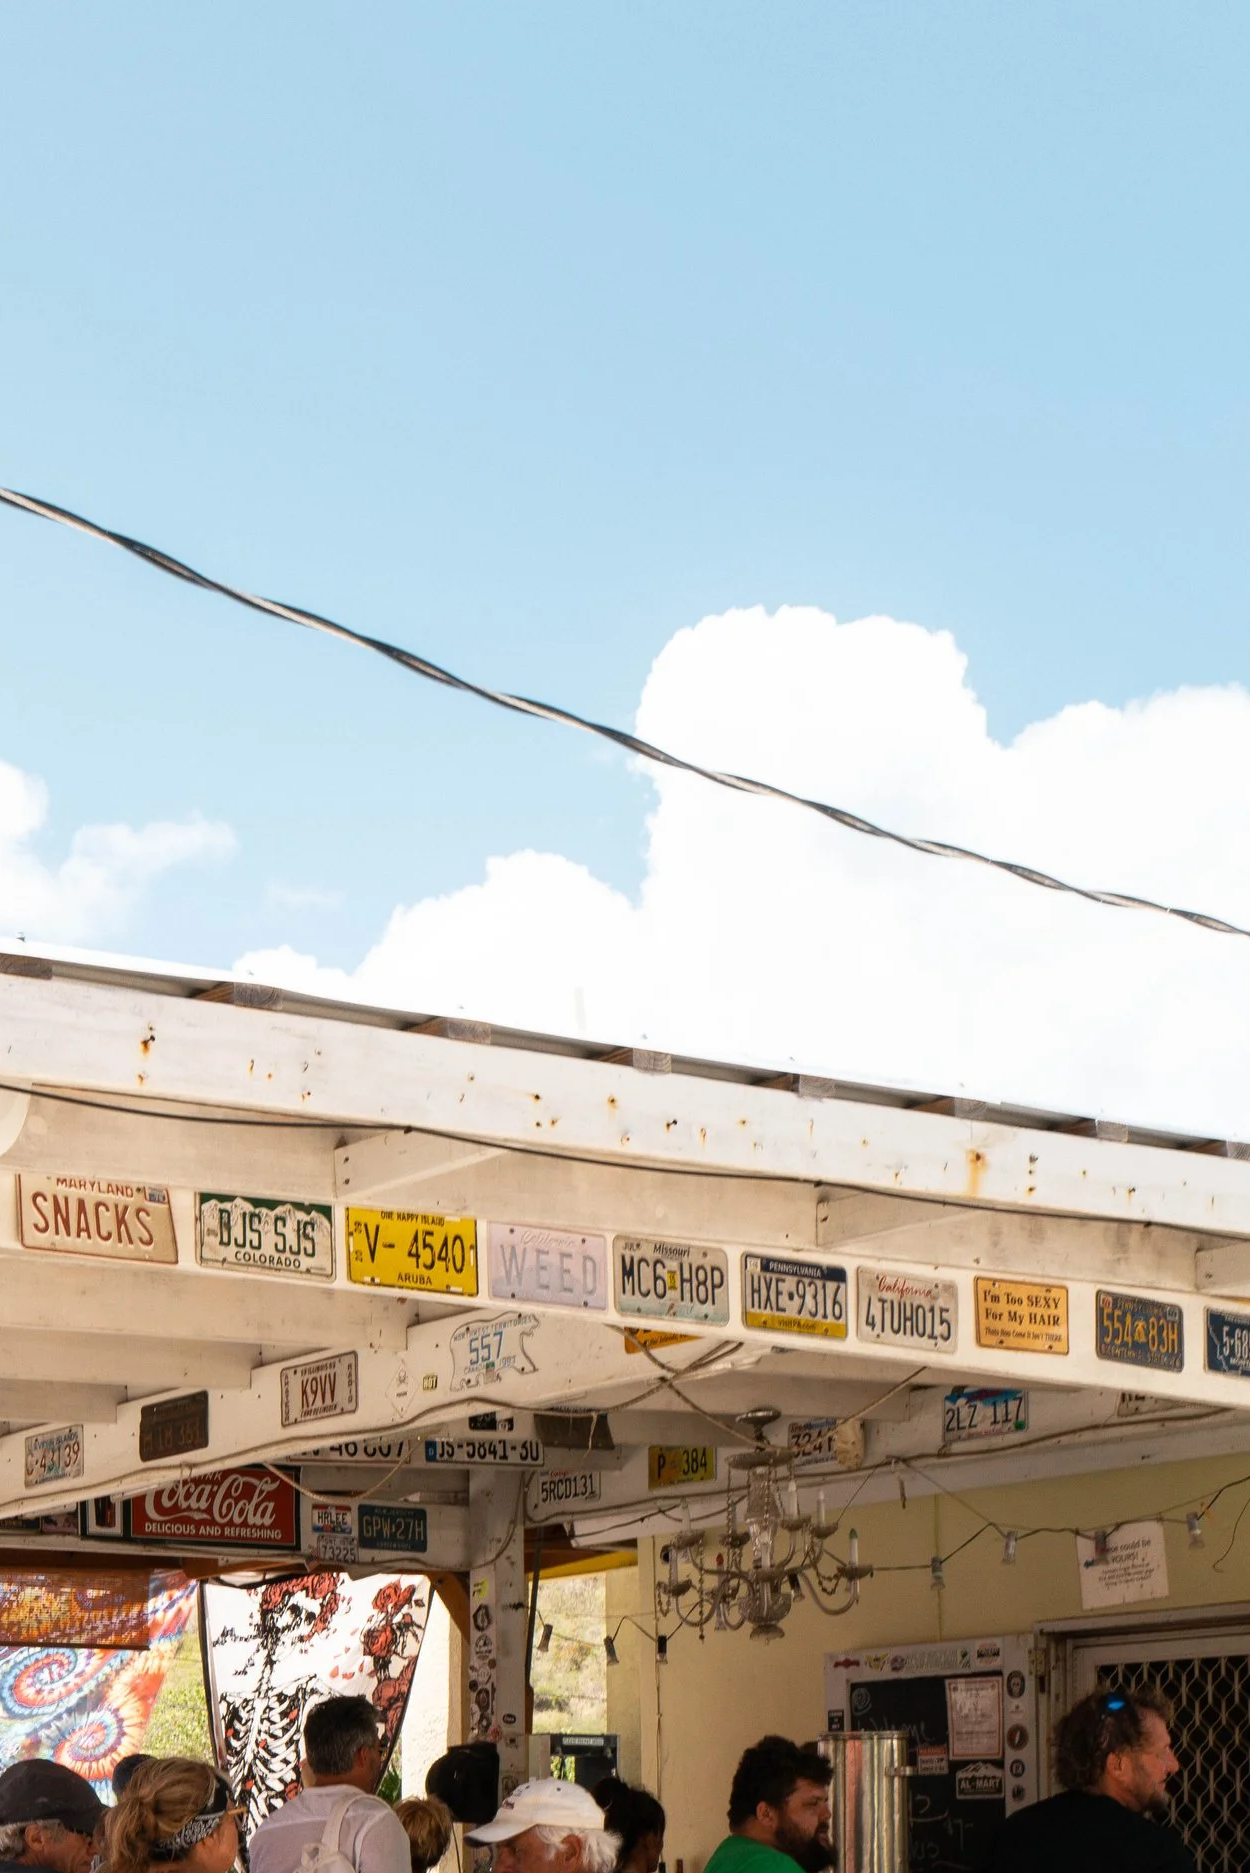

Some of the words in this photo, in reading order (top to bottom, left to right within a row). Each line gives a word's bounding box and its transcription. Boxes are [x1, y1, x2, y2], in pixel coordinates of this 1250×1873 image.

[56, 1177, 134, 1198] MARYLAND
[31, 1191, 154, 1246] SNACKS
[381, 1211, 393, 1220] ONE
[396, 1212, 419, 1223] HAPPY
[421, 1215, 445, 1227] ISLAND
[234, 1250, 301, 1269] COLORADO
[407, 1229, 465, 1274] 4540
[653, 1243, 690, 1258] Missouri
[397, 1272, 433, 1286] ARUBA
[500, 1244, 596, 1296] WEED
[621, 1253, 667, 1300] MC6
[679, 1262, 724, 1306] H8P
[769, 1261, 822, 1278] PENNSYLVANIA
[878, 1274, 933, 1301] California
[983, 1289, 1000, 1304] I'm
[1004, 1291, 1023, 1306] Too
[1027, 1294, 1061, 1309] SEXY
[985, 1307, 1003, 1321] For
[1008, 1309, 1025, 1326] My
[1029, 1312, 1060, 1326] HAIR
[1103, 1307, 1132, 1346] 554
[1149, 1316, 1178, 1354] 83H
[470, 1331, 503, 1365] 557
[301, 1372, 336, 1409] K9VV
[145, 1522, 196, 1534] DELICIOUS
[199, 1526, 221, 1536] AND
[225, 1527, 282, 1540] REFRESHING
